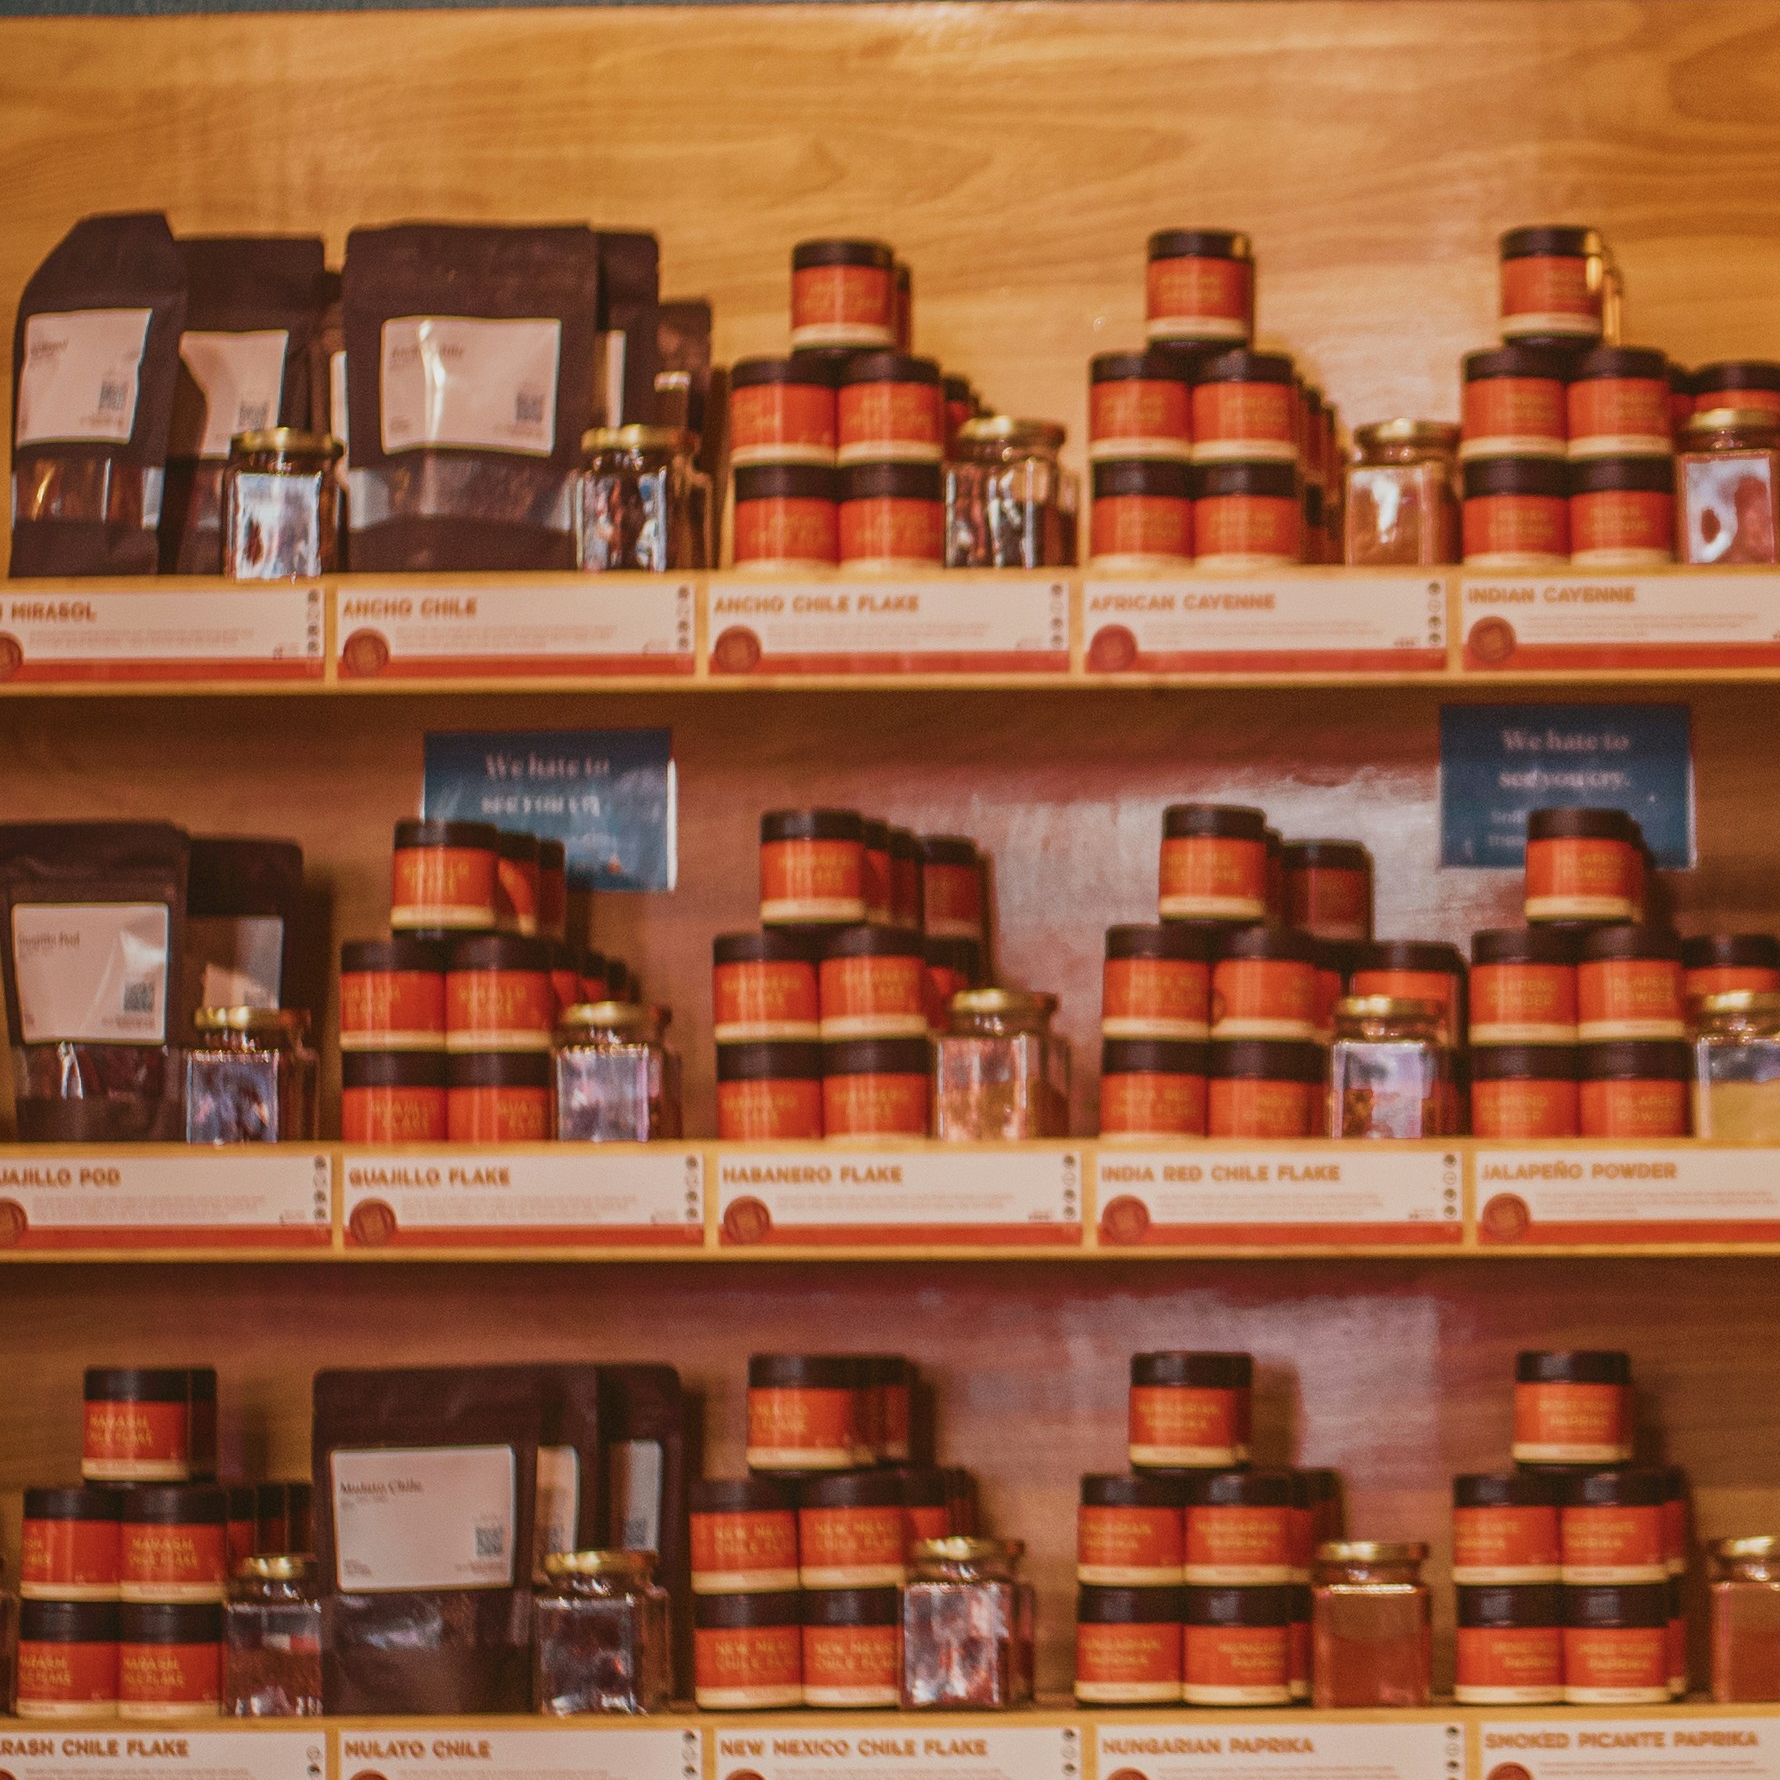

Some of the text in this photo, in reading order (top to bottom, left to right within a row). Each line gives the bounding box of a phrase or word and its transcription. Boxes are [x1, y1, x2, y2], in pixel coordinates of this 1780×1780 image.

[713, 595, 920, 614] ANCHO CHILE FLAKE
[1088, 593, 1276, 611] AFRICAN CAYENNE
[1468, 587, 1636, 604] INDIAN CAYENNE
[11, 601, 98, 620] MIRASOL
[343, 597, 478, 618] ANCHO CHILE
[79, 1168, 122, 1187] POD
[348, 1168, 511, 1186] GUAJILLO FLAKE
[722, 1164, 903, 1183] HABANERO FLAKE
[1100, 1164, 1341, 1183] INDIA RED CHILE FLAKE
[1481, 1160, 1679, 1181] JALAPEÑO POWDER
[62, 1739, 189, 1758] CHILE FLAKE
[343, 1740, 491, 1759] MULATO CHILE
[719, 1738, 987, 1757] NEW MEXICO CHILE FLAKE
[1102, 1737, 1316, 1755] HUNGARIAN PAPRIKA
[1484, 1731, 1759, 1749] SMOKED PICANTE PAPRIKA
